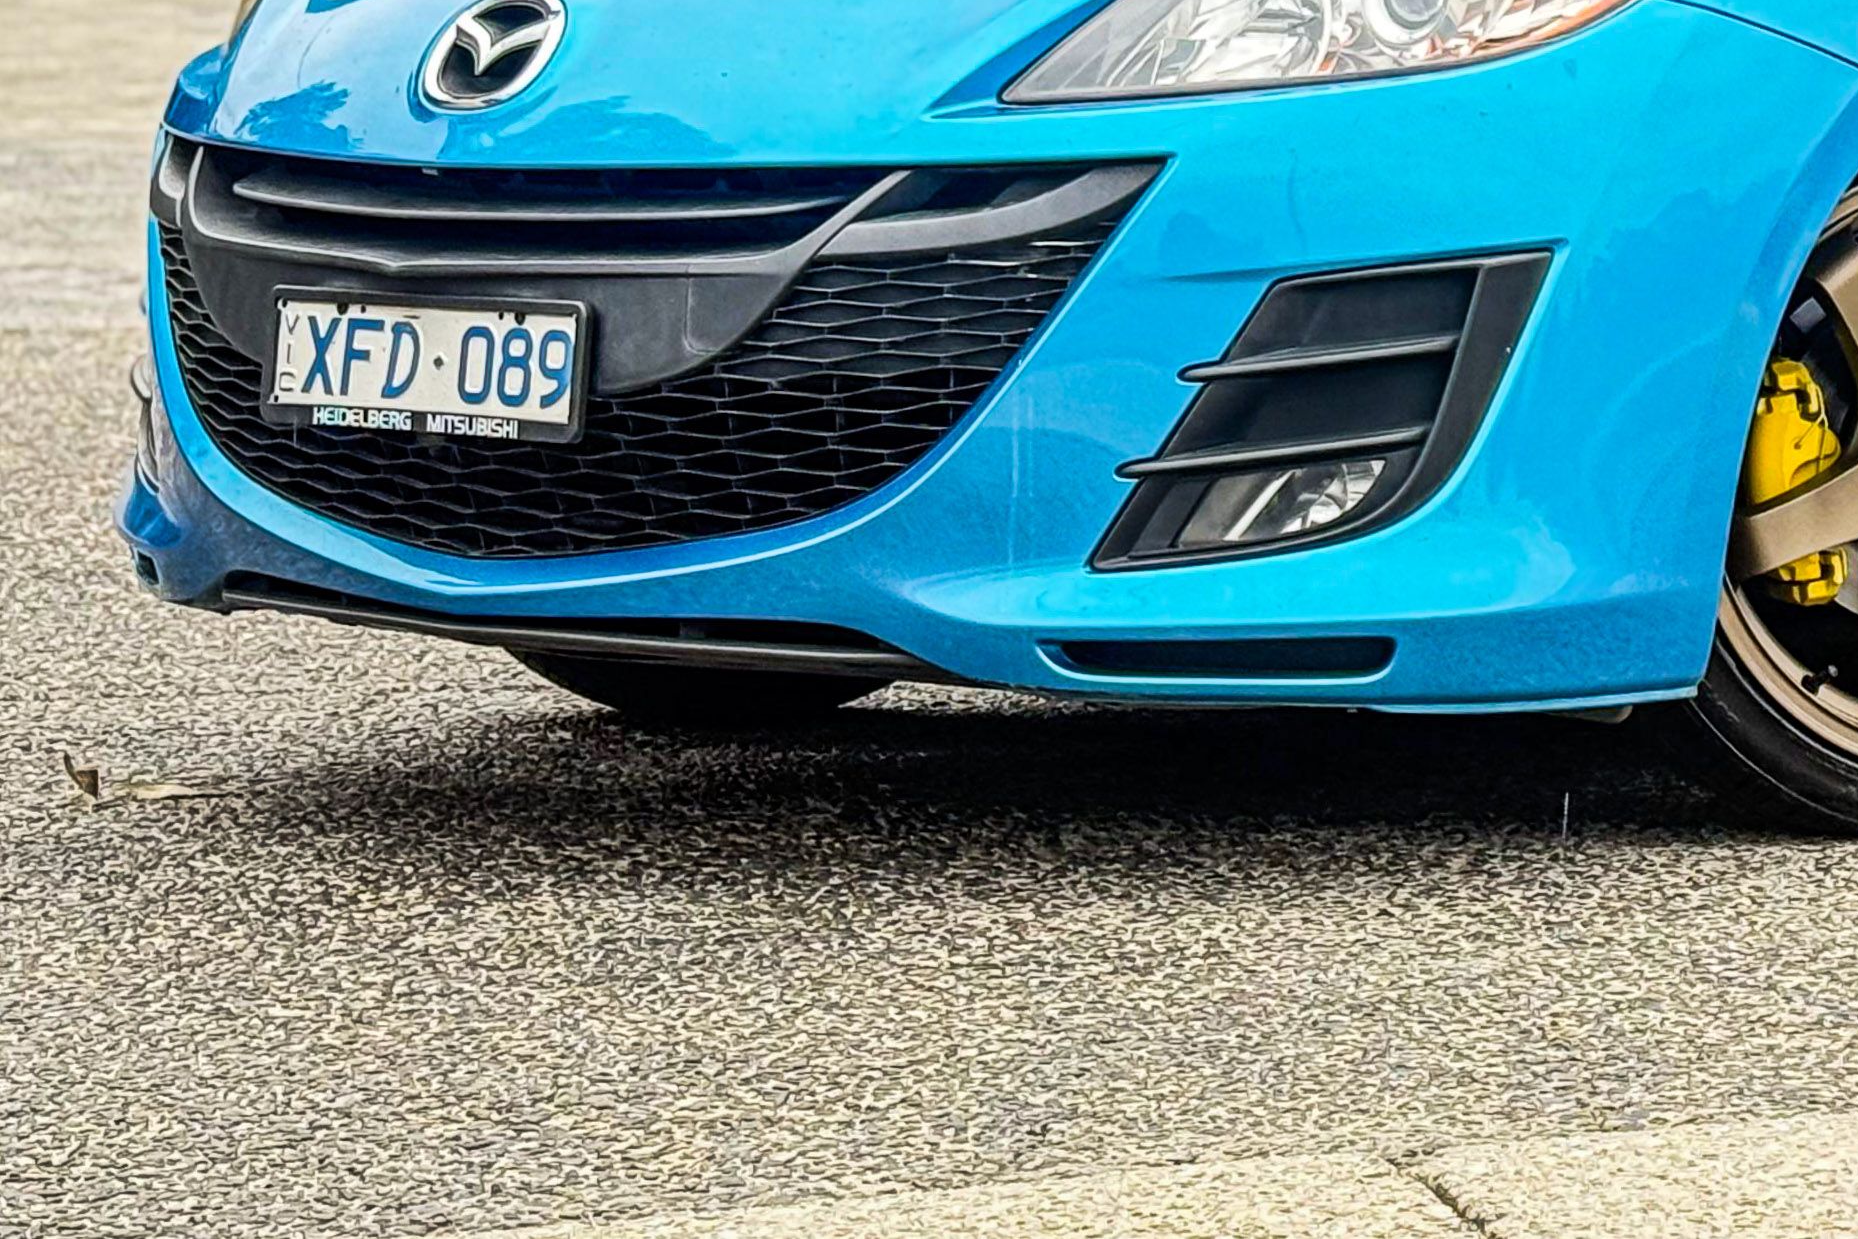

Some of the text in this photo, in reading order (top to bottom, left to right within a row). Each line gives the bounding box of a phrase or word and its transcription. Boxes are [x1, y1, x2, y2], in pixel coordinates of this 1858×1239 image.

[301, 315, 574, 410] XFD 089
[312, 405, 519, 439] HEIDELBERG MITSUBISHI
